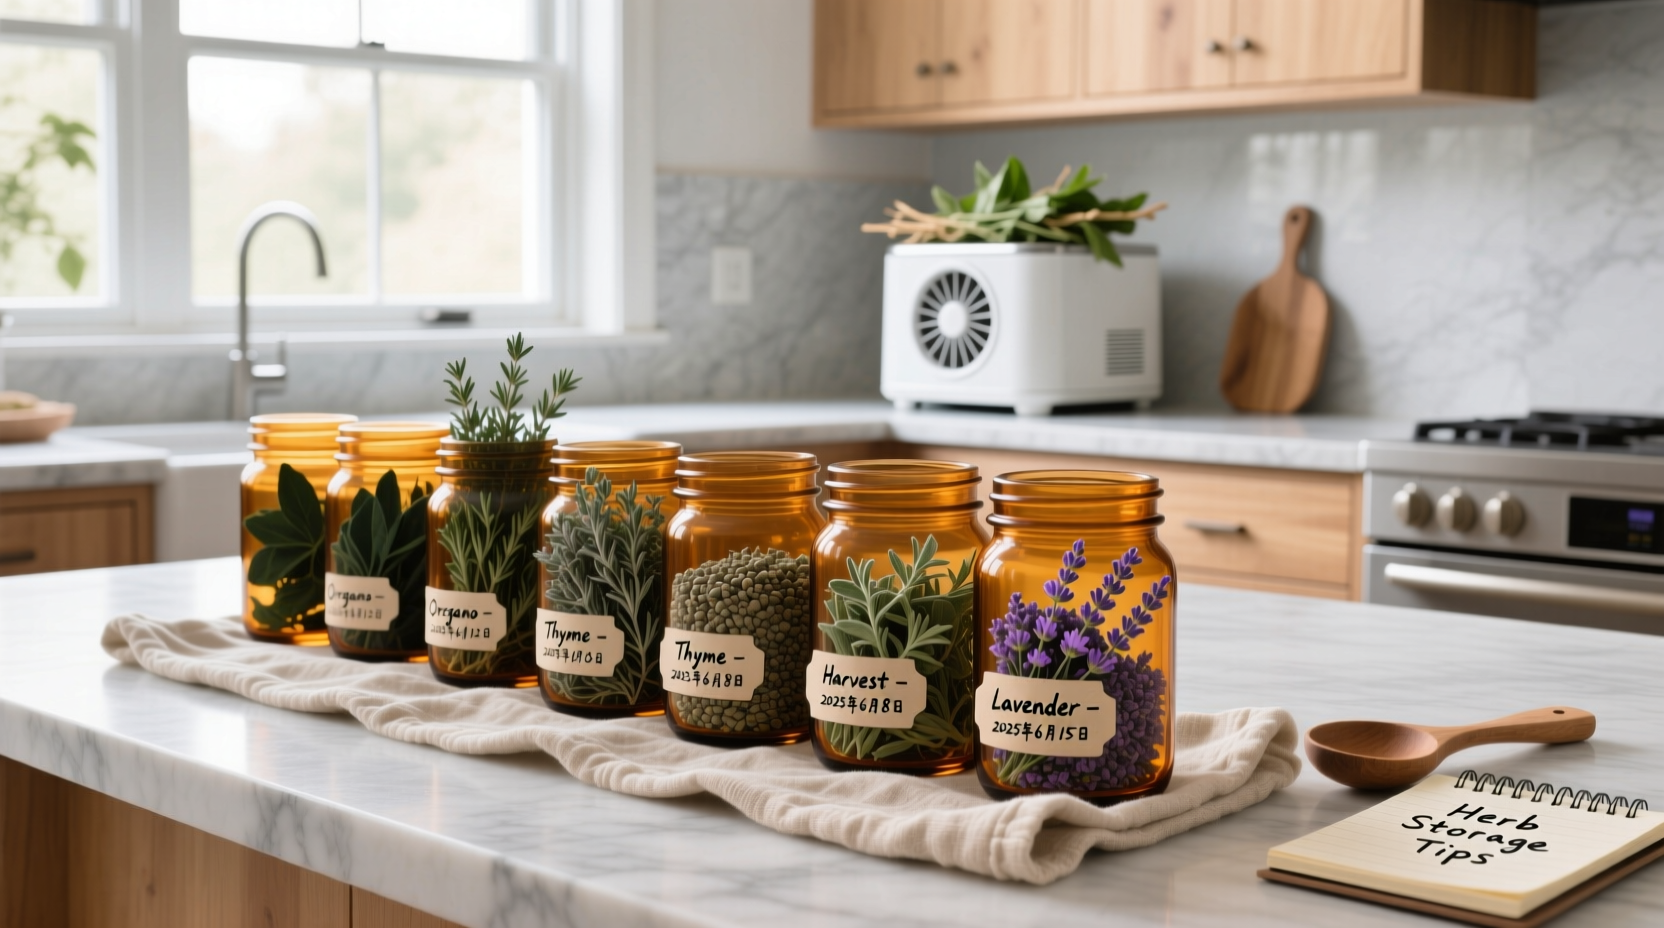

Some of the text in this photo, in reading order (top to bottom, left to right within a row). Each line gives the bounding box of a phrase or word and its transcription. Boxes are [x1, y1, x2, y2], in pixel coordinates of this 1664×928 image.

[429, 598, 478, 627] Oregano
[544, 620, 591, 648] Thyme
[675, 640, 727, 670] Thyme
[822, 664, 890, 690] Harvest
[820, 694, 903, 714] 2025年6月8日
[991, 687, 1081, 717] Lavender
[991, 721, 1088, 742] 2025年6月15日
[1446, 803, 1539, 831] Herb
[1401, 815, 1549, 854] Storage
[1416, 838, 1494, 866] Tips
